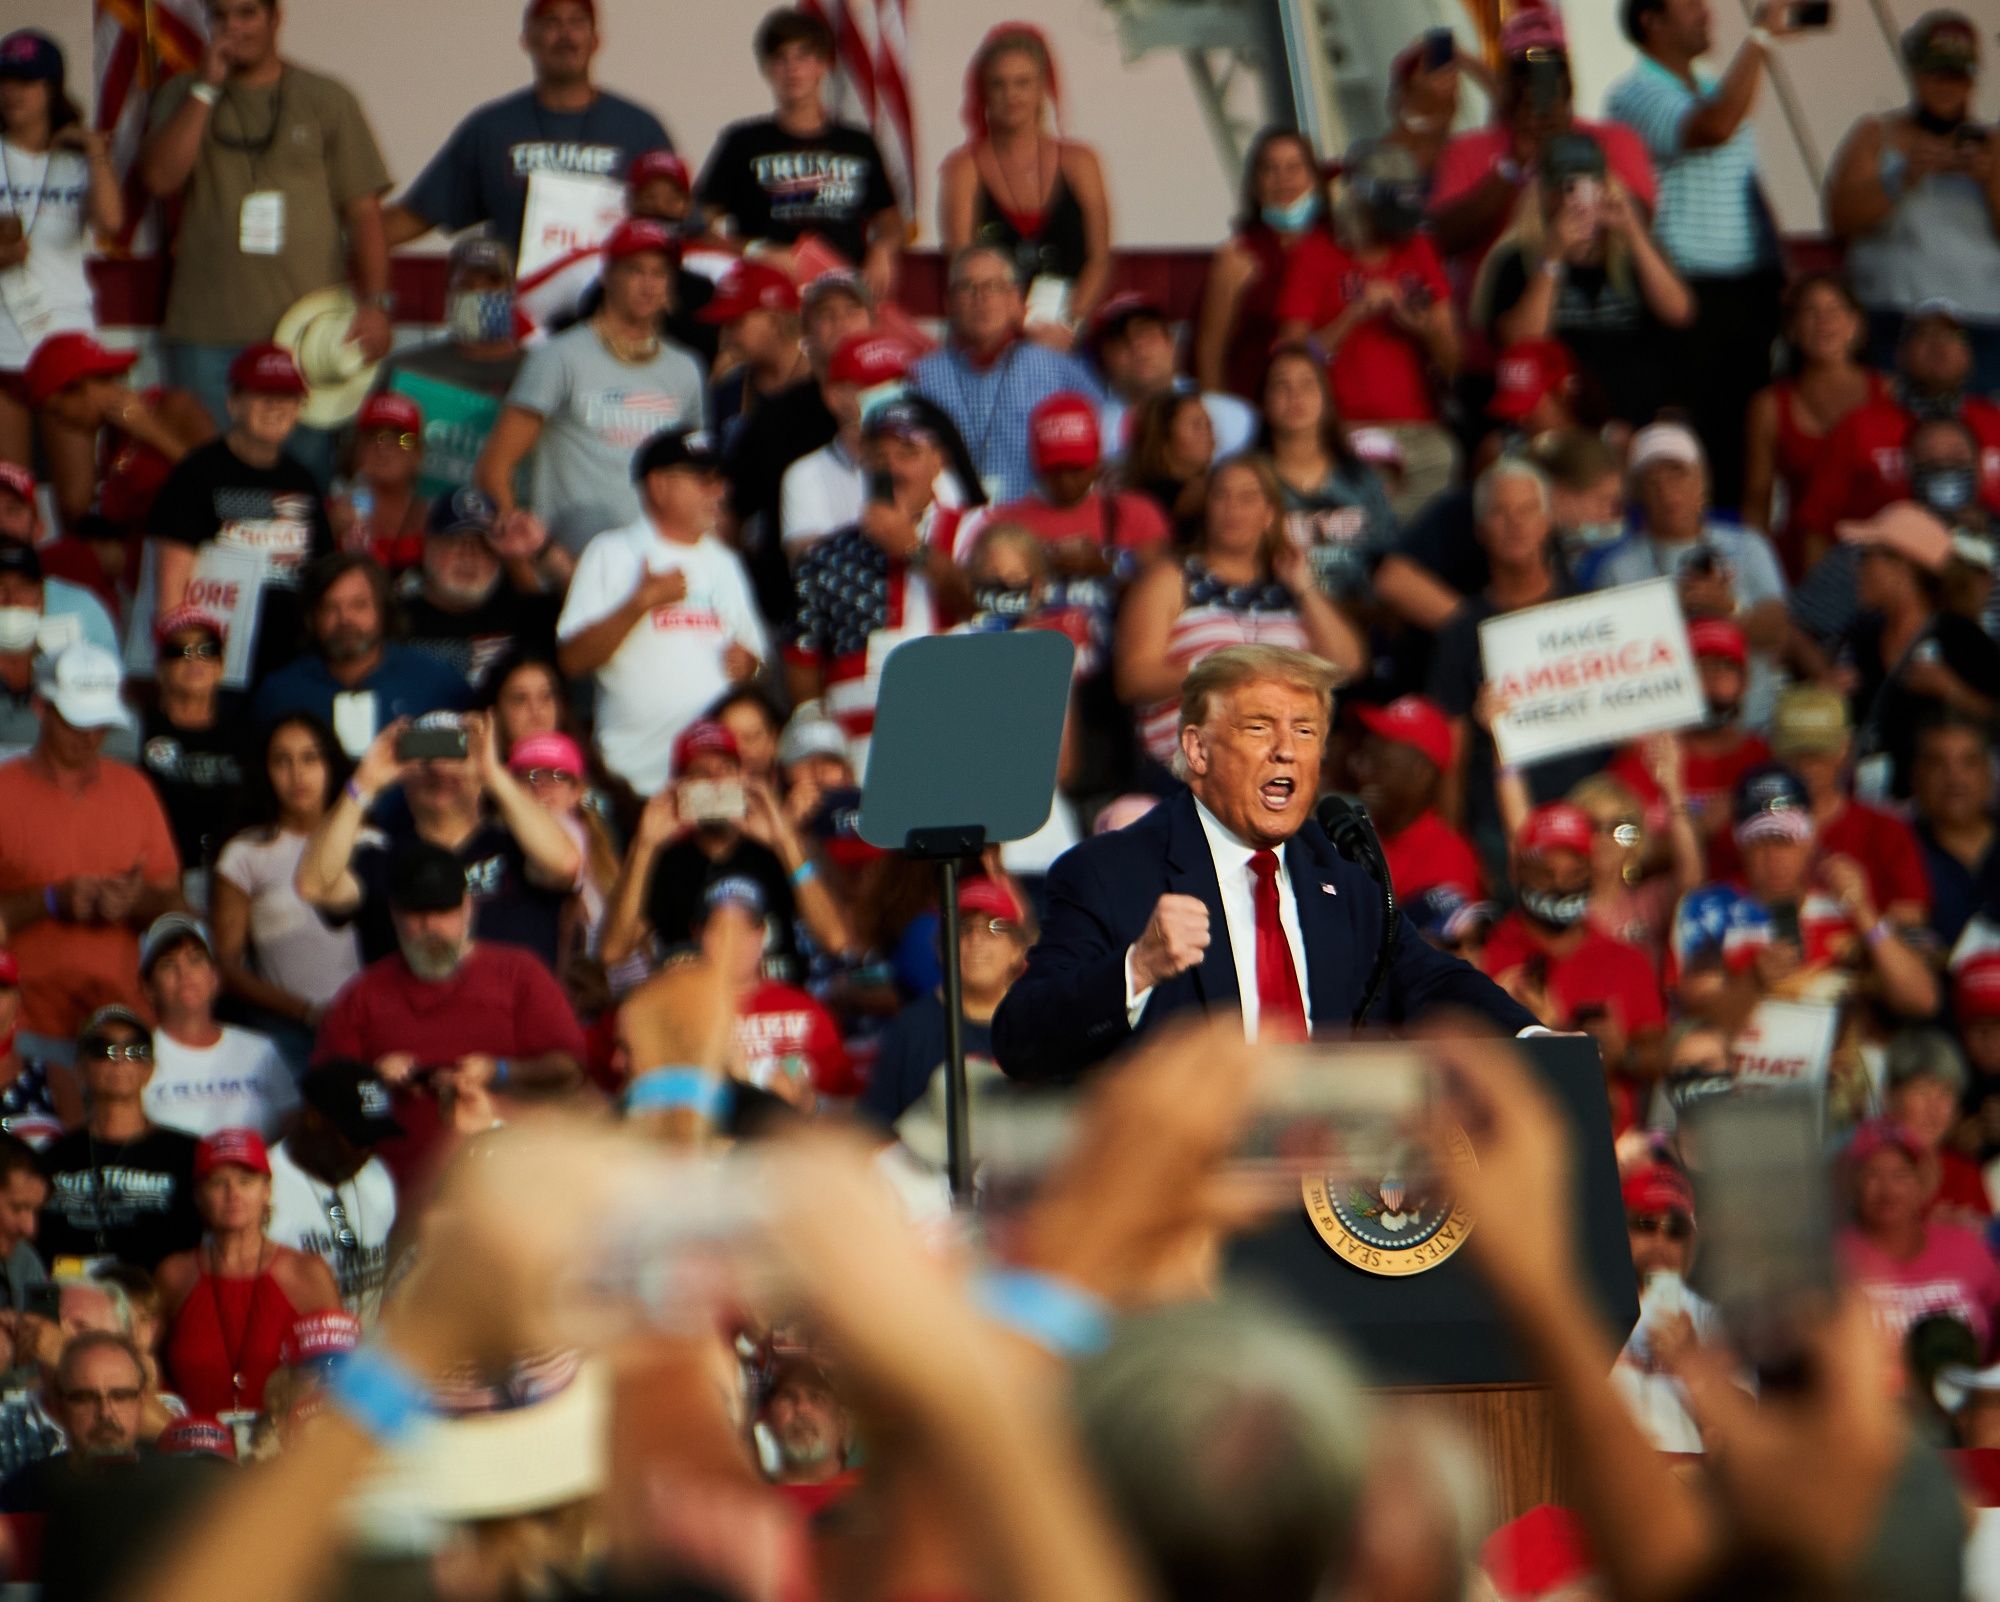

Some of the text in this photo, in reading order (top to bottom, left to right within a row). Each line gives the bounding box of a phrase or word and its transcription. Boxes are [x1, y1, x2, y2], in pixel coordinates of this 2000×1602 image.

[751, 155, 864, 184] TRUMP
[184, 578, 239, 612] ORE
[1537, 617, 1616, 651] MAKE
[1500, 639, 1675, 696] AMERICA
[1601, 678, 1682, 710] AGAIN
[101, 1166, 172, 1193] TRUMP
[1311, 1187, 1382, 1267] SEAL OF THE
[1414, 1208, 1471, 1265] STATES
